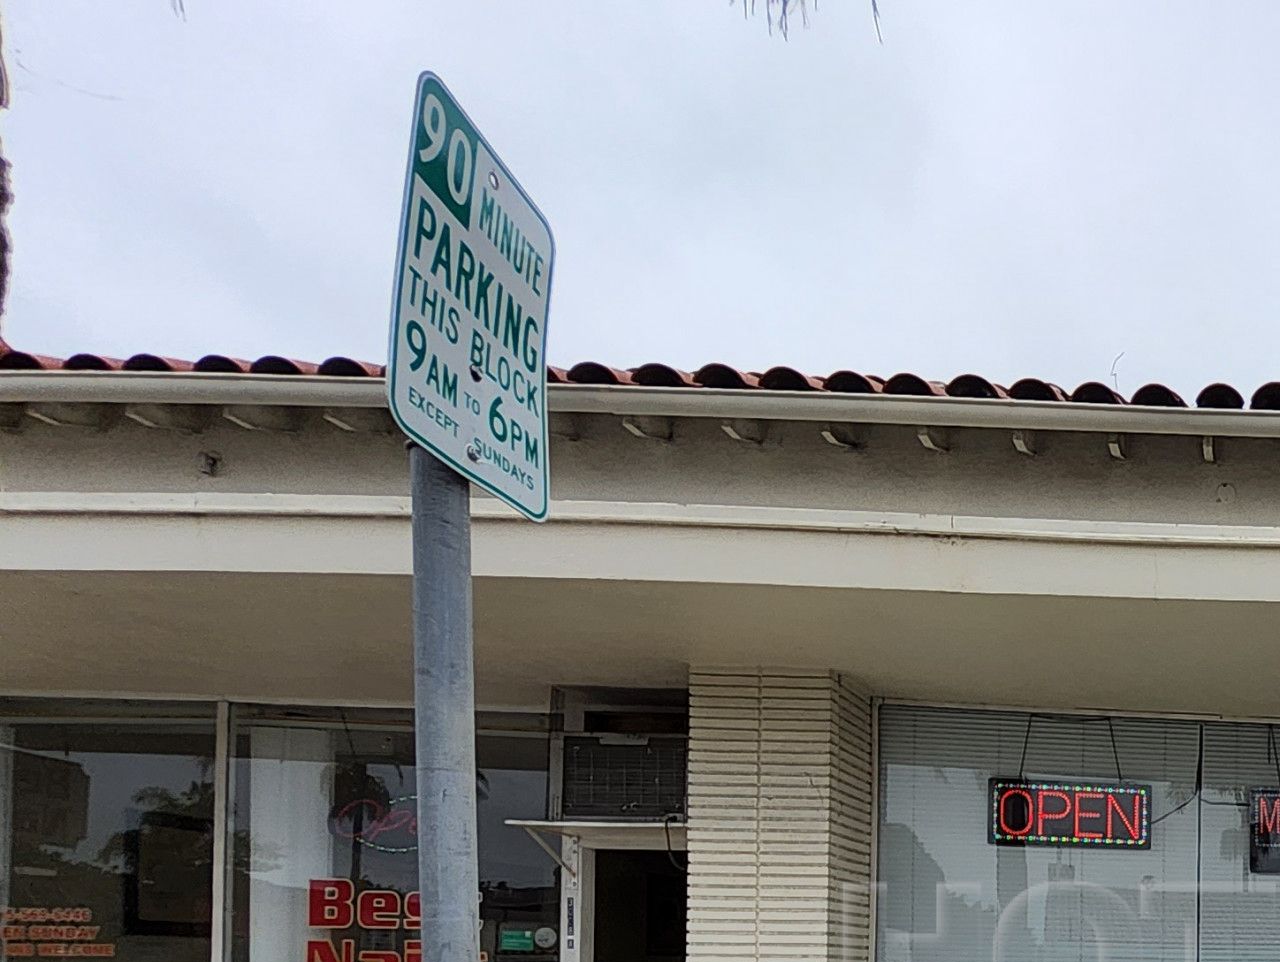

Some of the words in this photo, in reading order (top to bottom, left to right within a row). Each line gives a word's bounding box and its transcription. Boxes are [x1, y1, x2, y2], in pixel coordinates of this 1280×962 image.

[419, 94, 473, 206] 90
[478, 187, 543, 297] MINUTE
[414, 196, 539, 373] PARKING
[408, 266, 461, 345] THIS
[471, 328, 540, 418] BLOCK
[408, 386, 460, 439] EXCEPT
[473, 436, 535, 491] SUNDAYS
[464, 391, 481, 416] TO
[999, 789, 1140, 839] OPEN
[28, 925, 100, 940] SUNDAY
